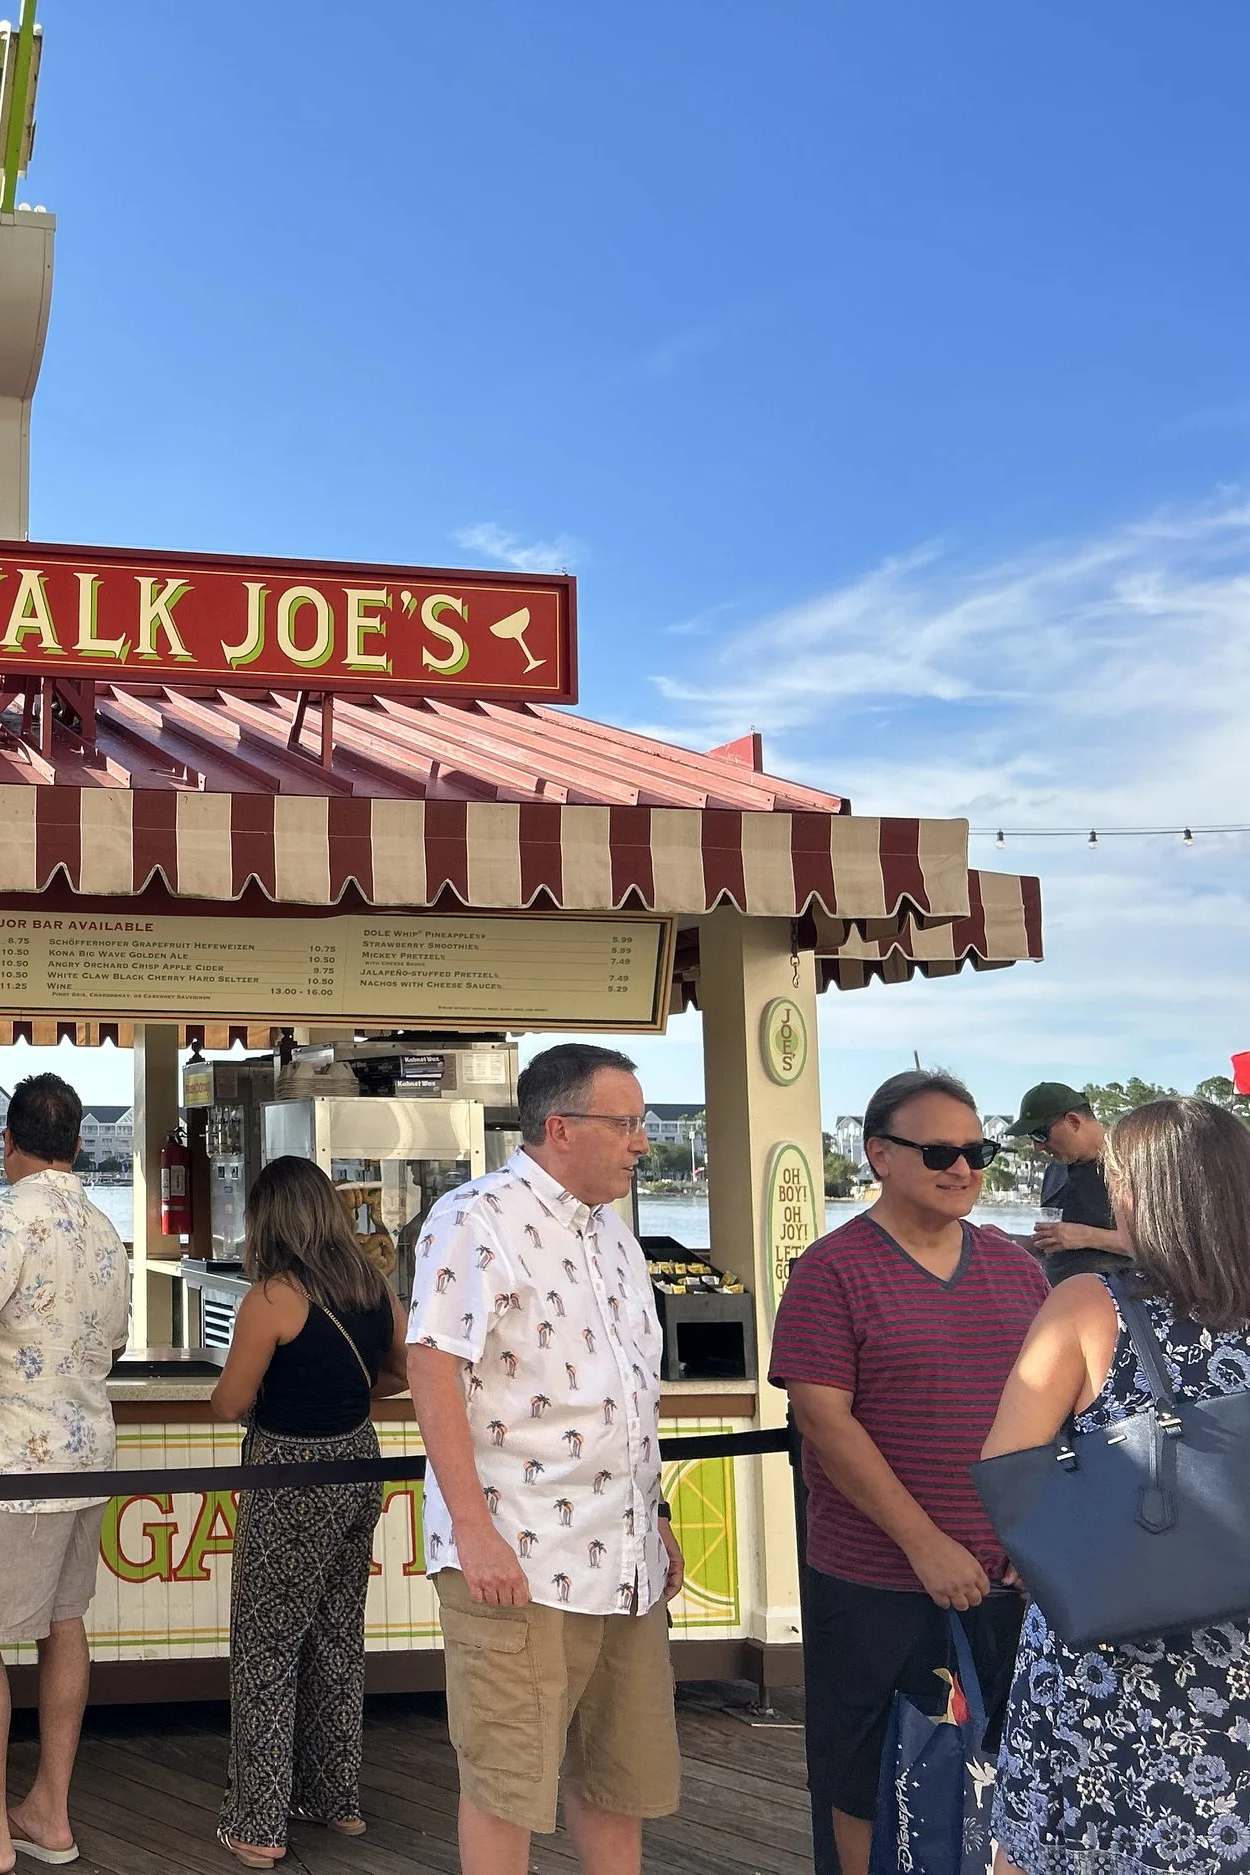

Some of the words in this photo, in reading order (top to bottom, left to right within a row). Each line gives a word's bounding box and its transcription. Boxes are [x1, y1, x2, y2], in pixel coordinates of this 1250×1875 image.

[221, 582, 469, 676] JOE'S
[32, 919, 63, 929] BAR
[67, 920, 154, 932] AVAILABLE
[7, 936, 30, 944] 8.75
[363, 928, 391, 937] DOLE
[424, 930, 477, 939] PINEAPPLE
[611, 935, 633, 943] 5.99
[1, 948, 29, 956] 10.50
[131, 940, 191, 948] GRAPEFRUIT
[193, 941, 255, 950] HEFEWEIZEN
[309, 944, 336, 953] 10.75
[361, 940, 425, 948] STRAWBERRY
[426, 941, 475, 950] SMOOTHIE
[610, 946, 632, 954] 5.99
[1, 959, 29, 967] 10.50
[48, 949, 75, 957] KONA
[78, 949, 95, 957] BIG
[97, 950, 126, 958] WAVE
[128, 951, 167, 959] GOLDEN
[169, 952, 189, 960] ALE
[308, 955, 335, 964] 10.50
[361, 951, 397, 959] MICKEY
[399, 952, 440, 960] PRETZEL
[609, 957, 631, 965] 7.49
[47, 960, 80, 968] ANGRY
[82, 960, 129, 969] ORCHARD
[130, 962, 160, 970] CRISP
[161, 962, 192, 971] APPLE
[194, 963, 224, 971] CIDER
[312, 966, 335, 974] 9.75
[0, 970, 28, 979] 10.50
[46, 971, 79, 979] WHITE
[80, 971, 110, 980] CLAW
[112, 972, 144, 980] BLACK
[146, 973, 186, 981] CHERRY
[188, 974, 215, 982] HARD
[217, 975, 259, 983] SELTZER
[307, 977, 334, 985] 10.50
[453, 970, 495, 979] PRETZEL
[608, 974, 629, 982] 7.49
[0, 982, 27, 990] 11.25
[46, 982, 72, 990] WINE
[270, 987, 297, 995] 13.00
[306, 988, 333, 996] 16.00
[359, 979, 397, 987] NACHOS
[425, 980, 463, 989] CHEESE
[465, 981, 499, 989] SAUCE
[607, 985, 628, 993] 5.29
[781, 1008, 796, 1071] JOE'S
[783, 1168, 800, 1185] OH
[779, 1185, 807, 1202] BOY!
[784, 1206, 802, 1223] OH
[780, 1224, 808, 1241] JOY!
[775, 1245, 805, 1262] LET'
